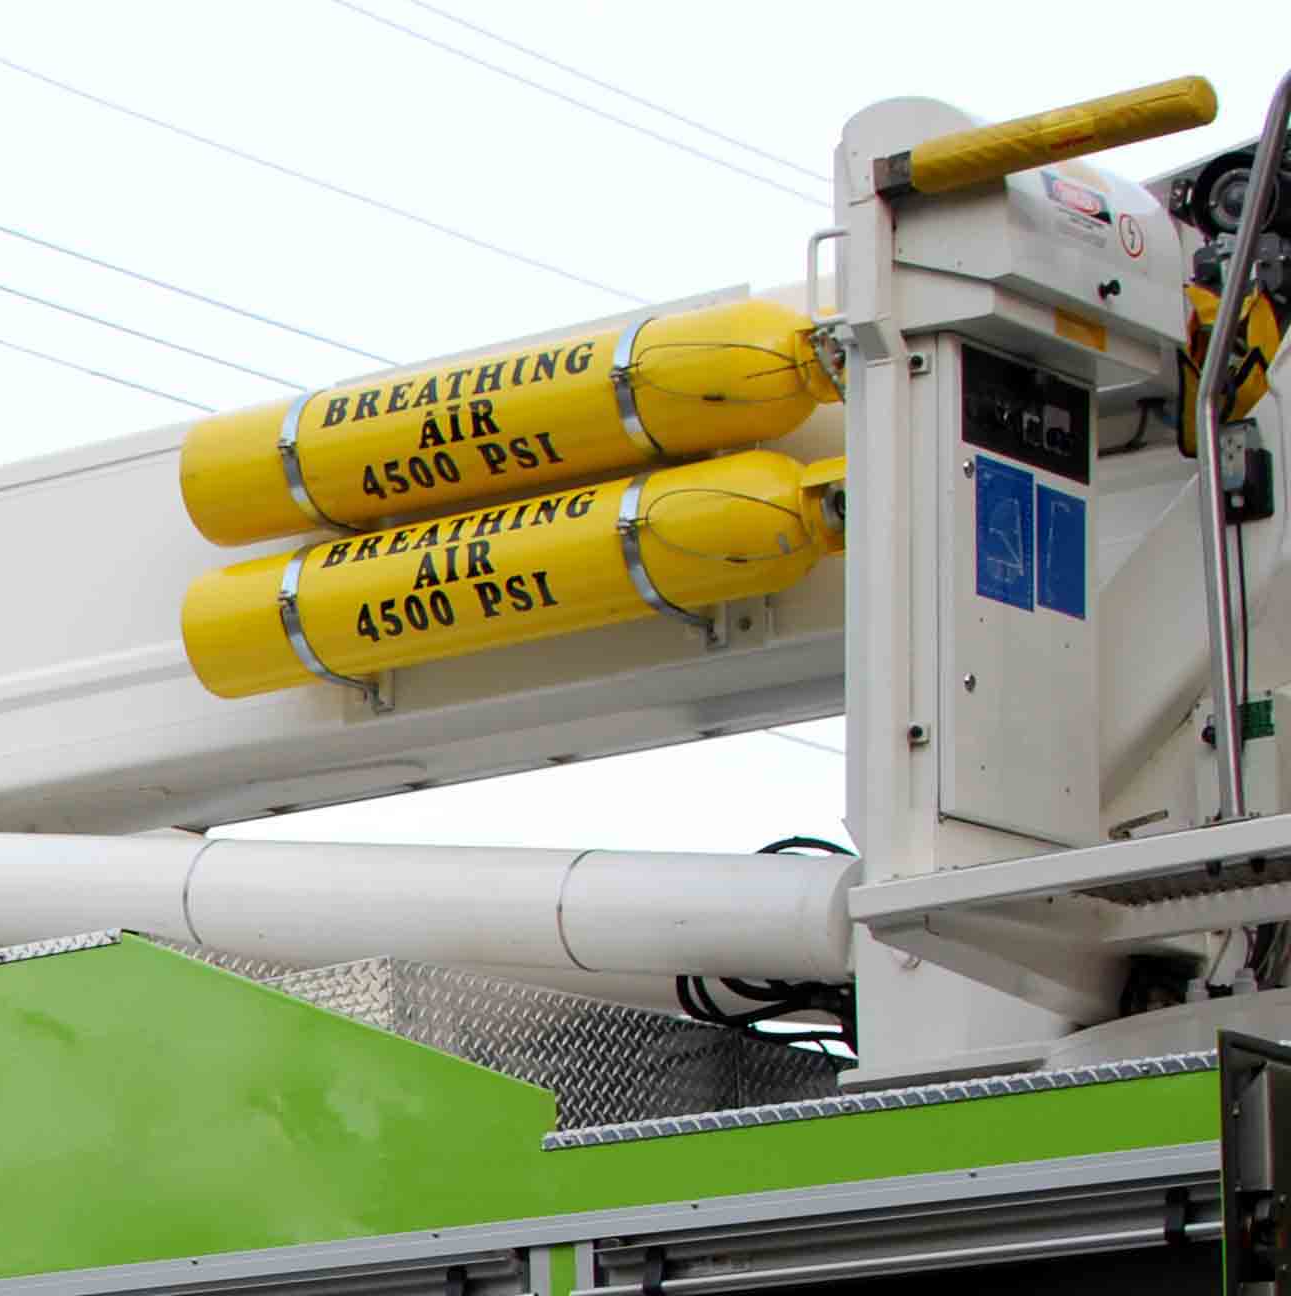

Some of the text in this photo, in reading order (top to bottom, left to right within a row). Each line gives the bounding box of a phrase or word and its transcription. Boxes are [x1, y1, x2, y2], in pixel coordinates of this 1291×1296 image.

[322, 341, 595, 428] BREATHING
[419, 399, 500, 450] AIR
[362, 432, 564, 499] 4500 PSI
[321, 491, 597, 568] BREATHING
[413, 539, 494, 590] AIR
[356, 571, 558, 642] 4500 PSI
